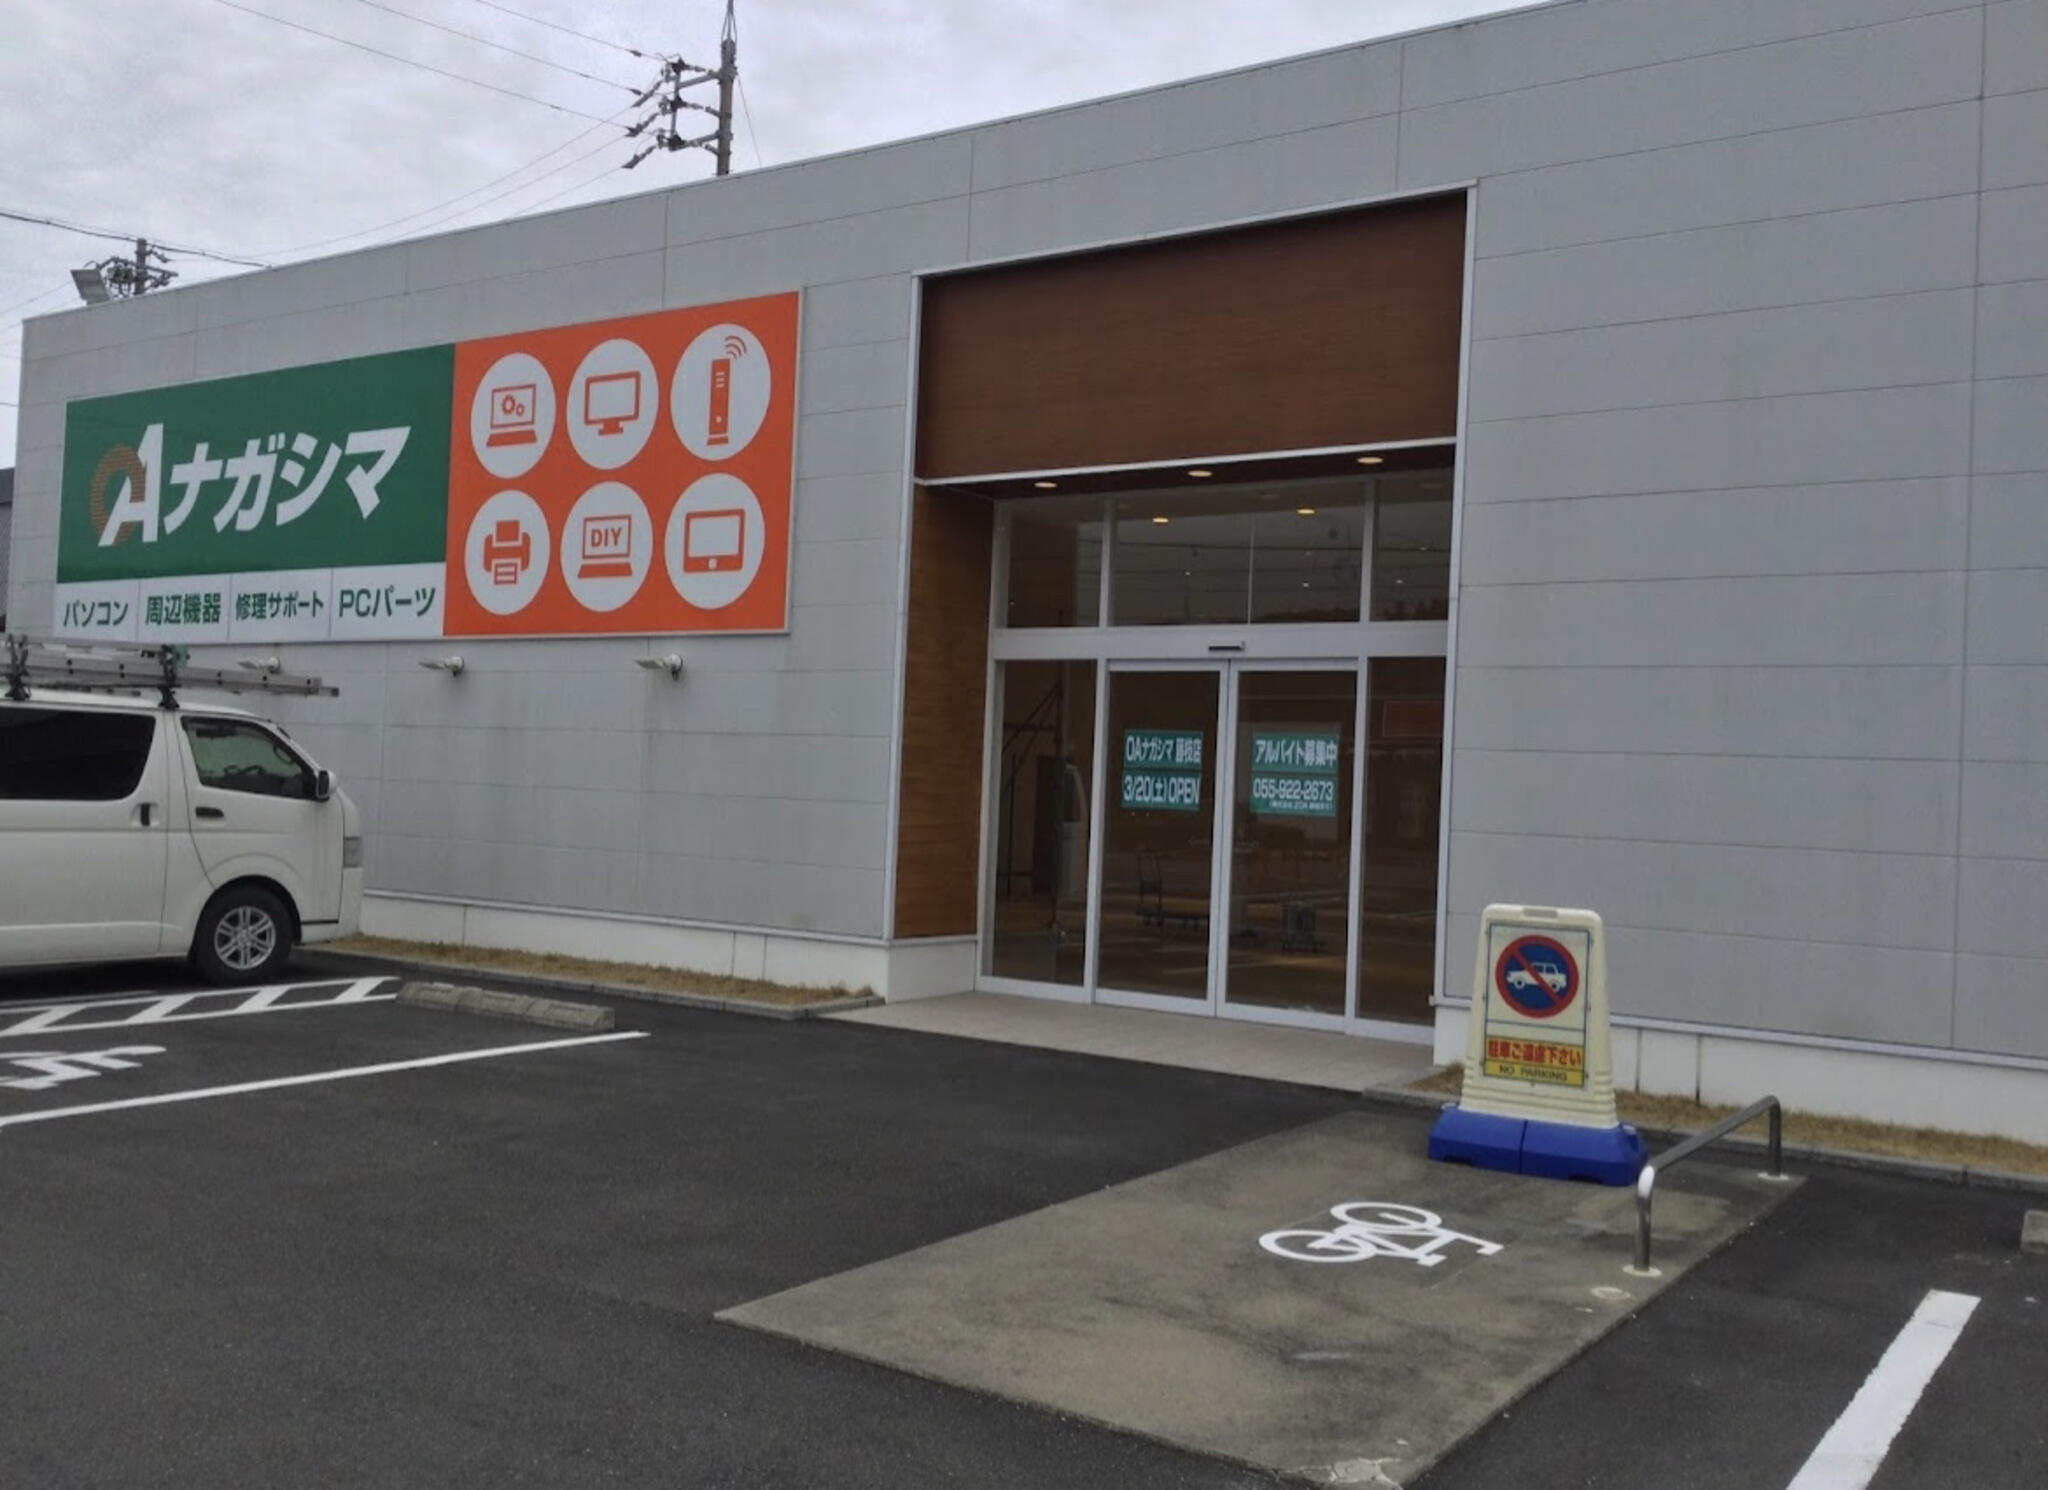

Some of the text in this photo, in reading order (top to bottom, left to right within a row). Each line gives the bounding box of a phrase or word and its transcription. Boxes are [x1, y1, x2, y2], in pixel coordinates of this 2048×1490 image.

[591, 527, 622, 547] DIY
[63, 585, 437, 627] パソコン 周辺機器 修理サポート PCパーツ
[1254, 738, 1338, 768] アルバイト募集中
[1168, 776, 1201, 805] OPEN
[1253, 777, 1334, 801] 055-922-2673
[1499, 1064, 1568, 1081] NO PARKING
